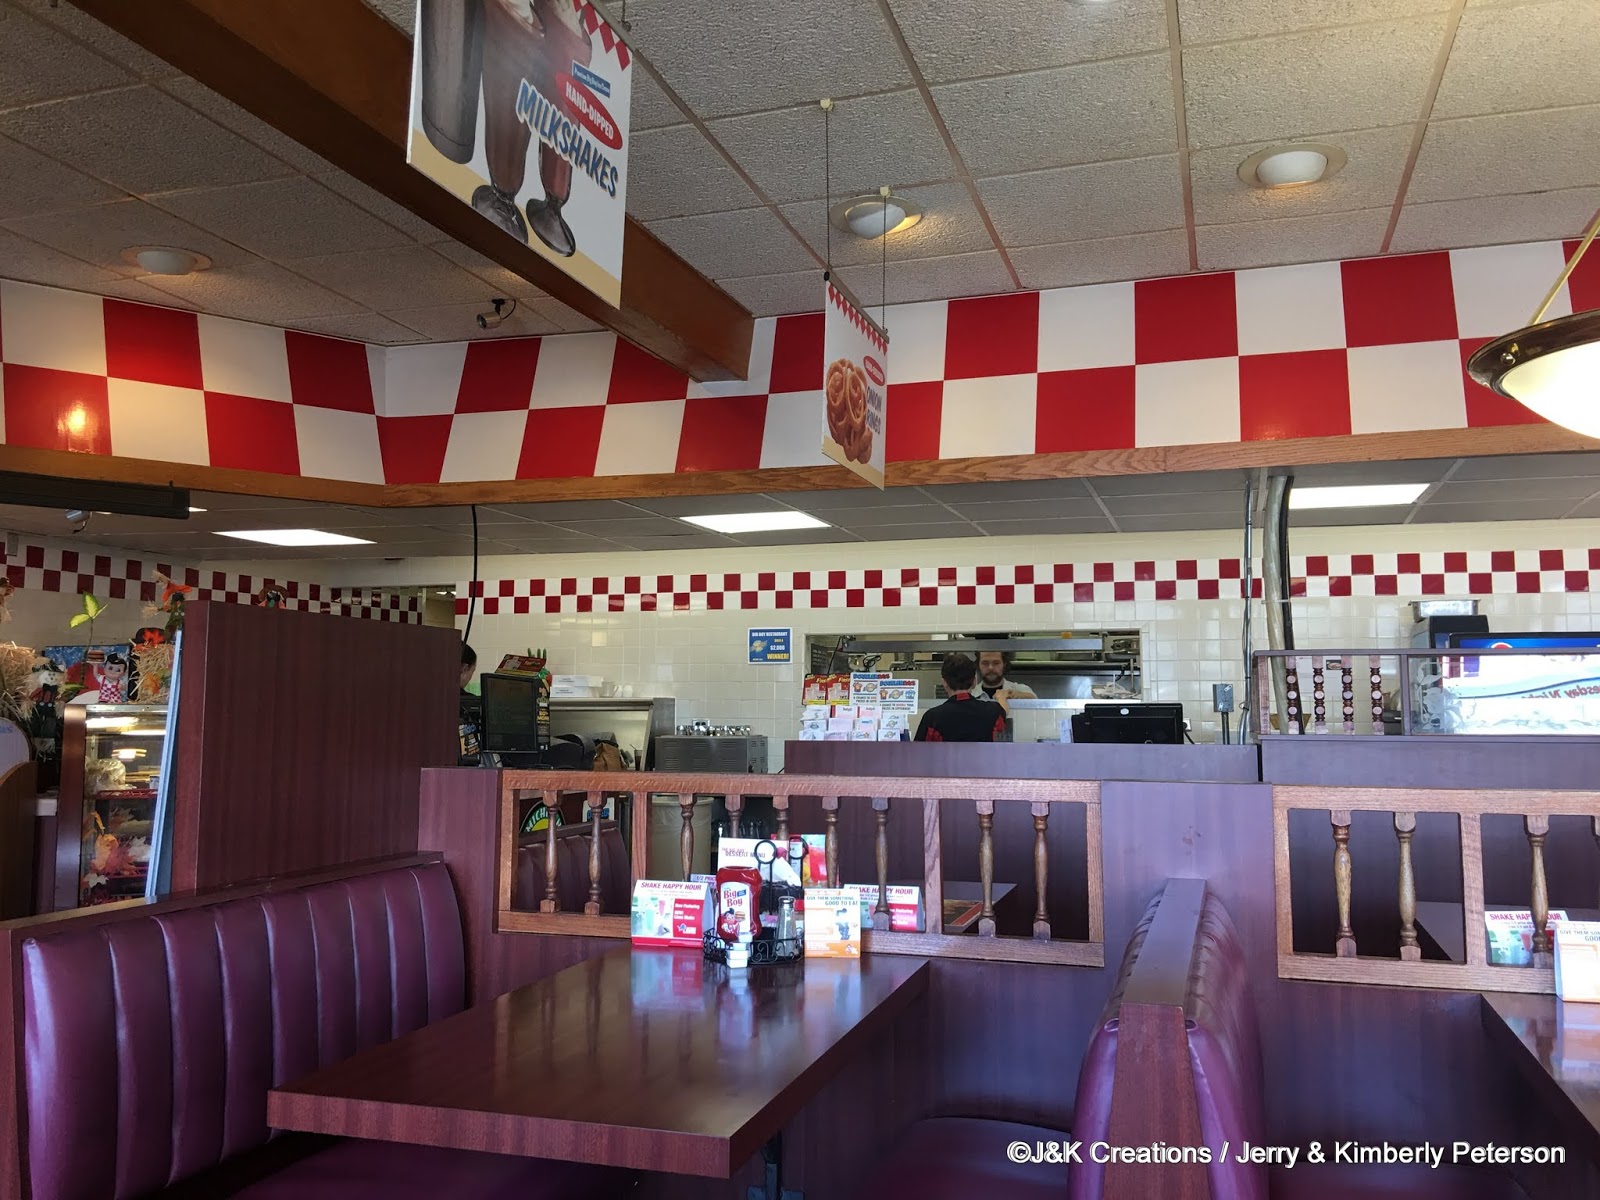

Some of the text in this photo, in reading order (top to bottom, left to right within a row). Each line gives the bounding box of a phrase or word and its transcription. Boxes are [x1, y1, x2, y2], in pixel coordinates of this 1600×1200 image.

[565, 81, 614, 140] HAND-DIPPED
[516, 79, 619, 199] MILKSHAKES
[725, 850, 749, 858] DESSERT
[640, 881, 662, 889] SHAKE
[662, 882, 684, 890] HAPPY
[723, 890, 737, 899] Big
[872, 887, 894, 895] HAPY
[726, 898, 743, 907] Boy
[1489, 912, 1563, 921] SHAKE HAP OUR
